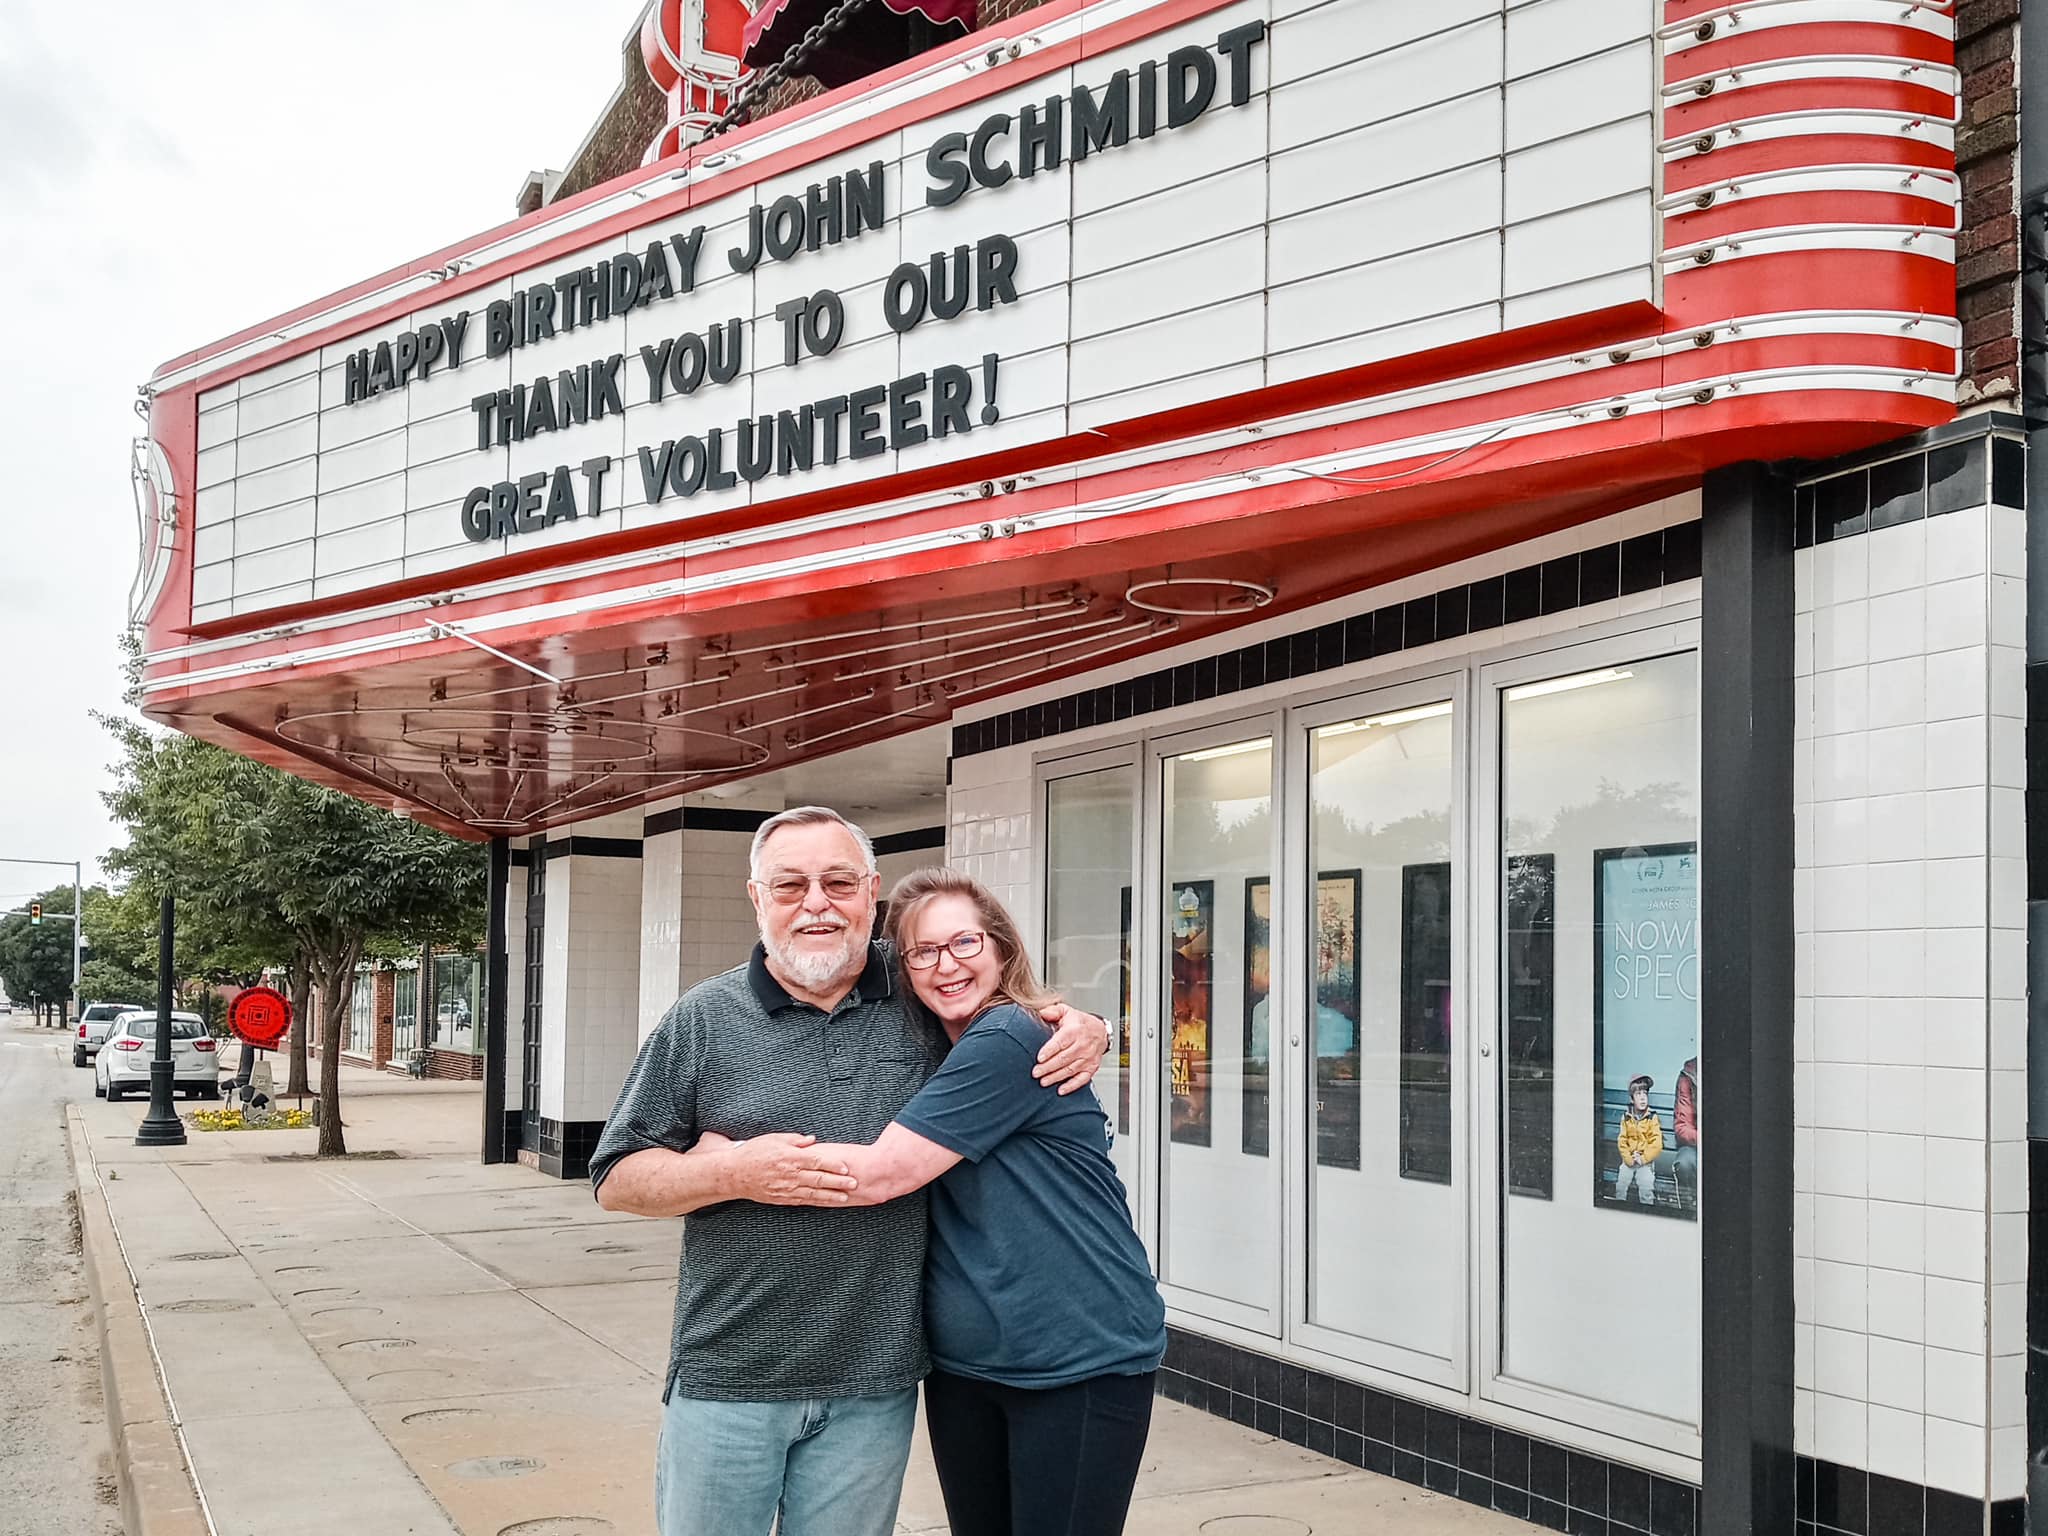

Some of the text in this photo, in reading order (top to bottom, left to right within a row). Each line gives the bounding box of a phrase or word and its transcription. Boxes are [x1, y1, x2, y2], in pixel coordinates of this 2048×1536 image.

[345, 19, 1265, 405] HAPPY BIRTHDAY JOHN SCHMIDT
[472, 234, 1018, 450] THANK YOU TO OUR
[461, 353, 999, 543] GREAT VOLUNTEER!
[1615, 920, 1697, 951] NOW
